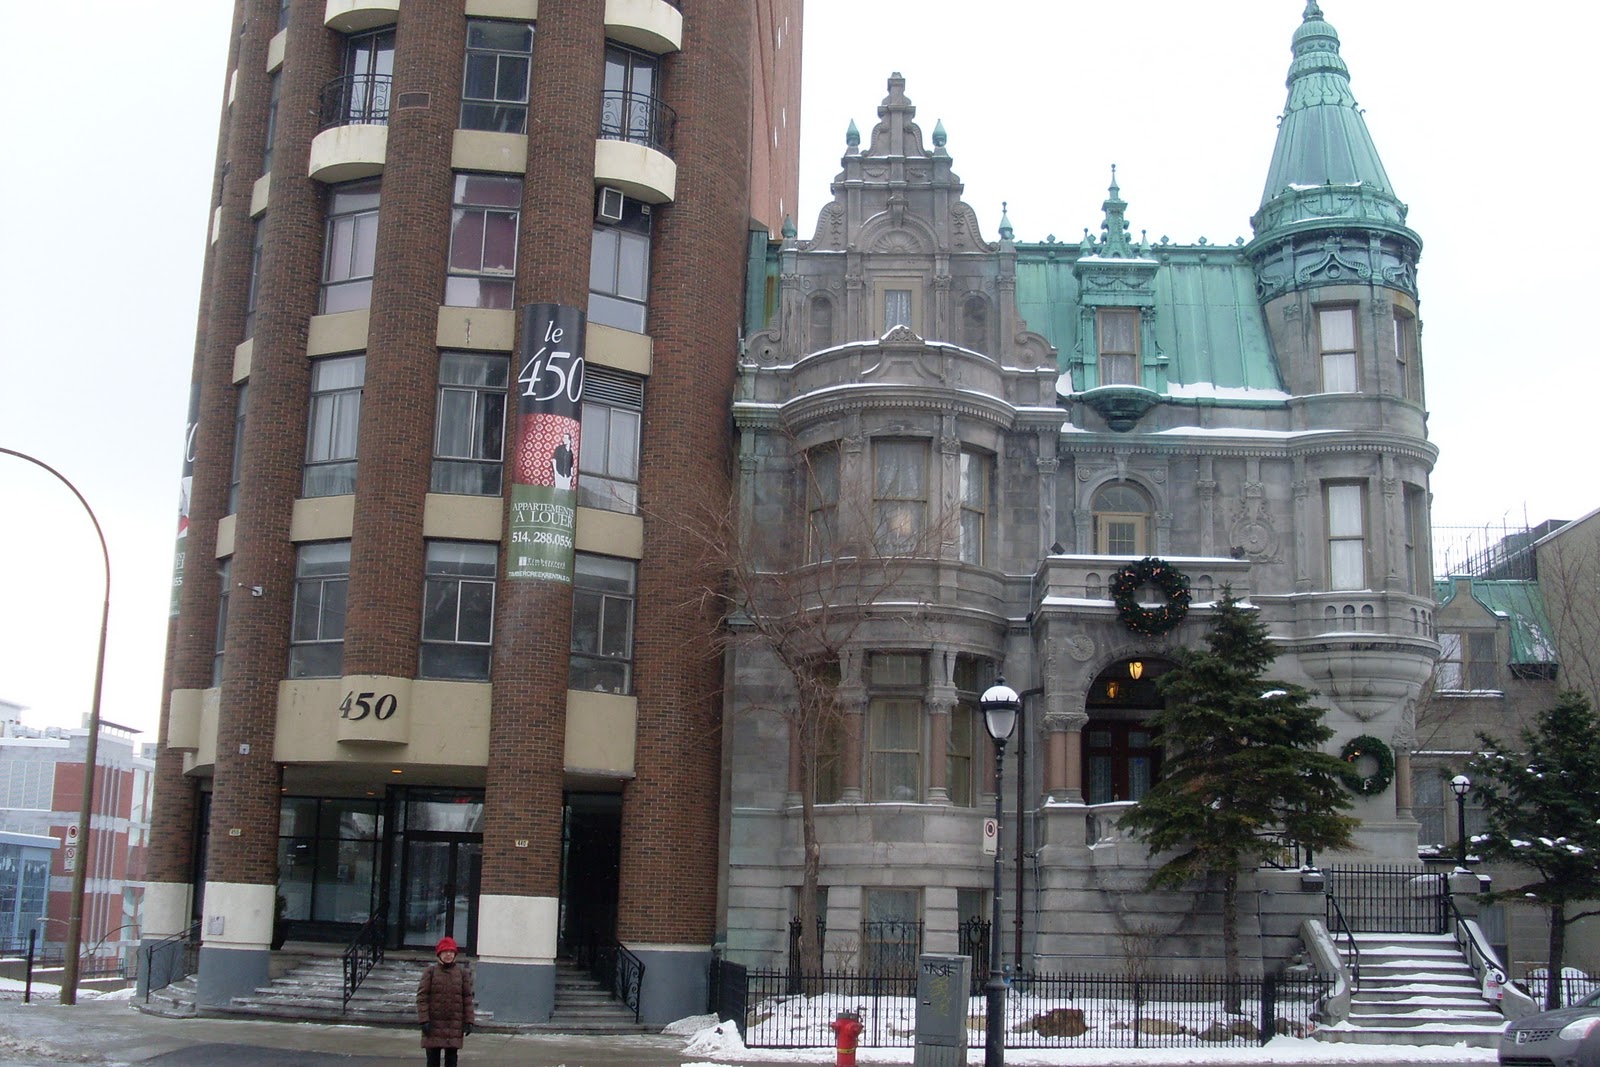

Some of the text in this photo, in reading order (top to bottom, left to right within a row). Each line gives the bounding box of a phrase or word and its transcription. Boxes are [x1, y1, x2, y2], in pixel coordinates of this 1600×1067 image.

[544, 320, 563, 343] le
[518, 347, 584, 403] 450
[530, 511, 573, 529] LOUER
[533, 531, 573, 549] 288.0556
[338, 690, 398, 721] 450
